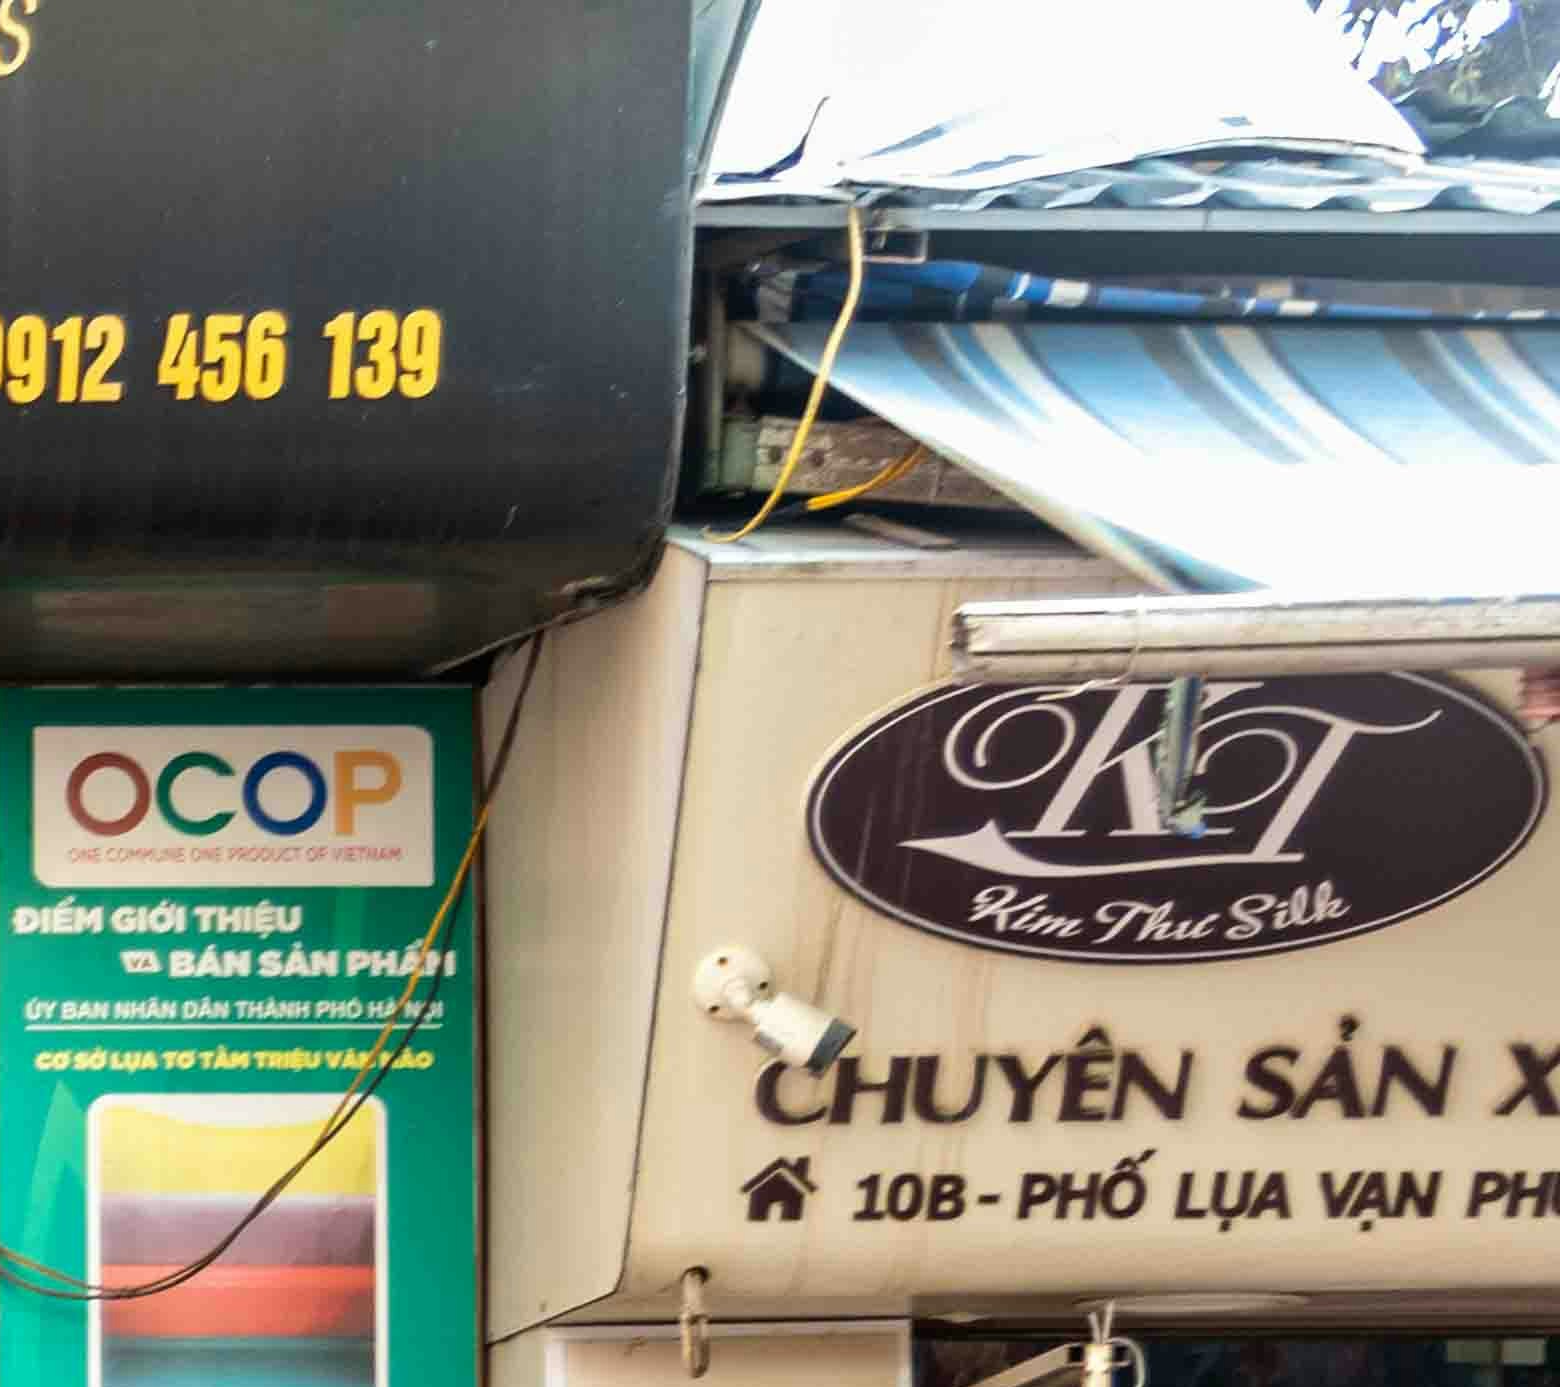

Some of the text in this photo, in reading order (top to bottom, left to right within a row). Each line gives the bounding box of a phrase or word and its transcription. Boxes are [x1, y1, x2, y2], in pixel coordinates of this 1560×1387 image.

[157, 309, 288, 403] 456
[323, 308, 443, 400] 139
[65, 749, 403, 837] OCOP
[227, 847, 302, 863] PRODUCT
[306, 847, 329, 863] OF
[194, 900, 303, 940] THIỆU
[968, 884, 1084, 940] Kim
[1224, 878, 1352, 942] Silk
[168, 943, 251, 978] BÁN
[61, 1001, 109, 1020] BAN
[114, 996, 177, 1020] NHÂN
[181, 996, 235, 1020] DÂN
[755, 1015, 1560, 1126] CHUYÊN SẢN X
[853, 1172, 966, 1222] 10B
[1017, 1148, 1156, 1220] PHỐ
[1174, 1171, 1291, 1232] LỤA
[1319, 1171, 1442, 1232] VẠN
[1466, 1171, 1560, 1219] PH
